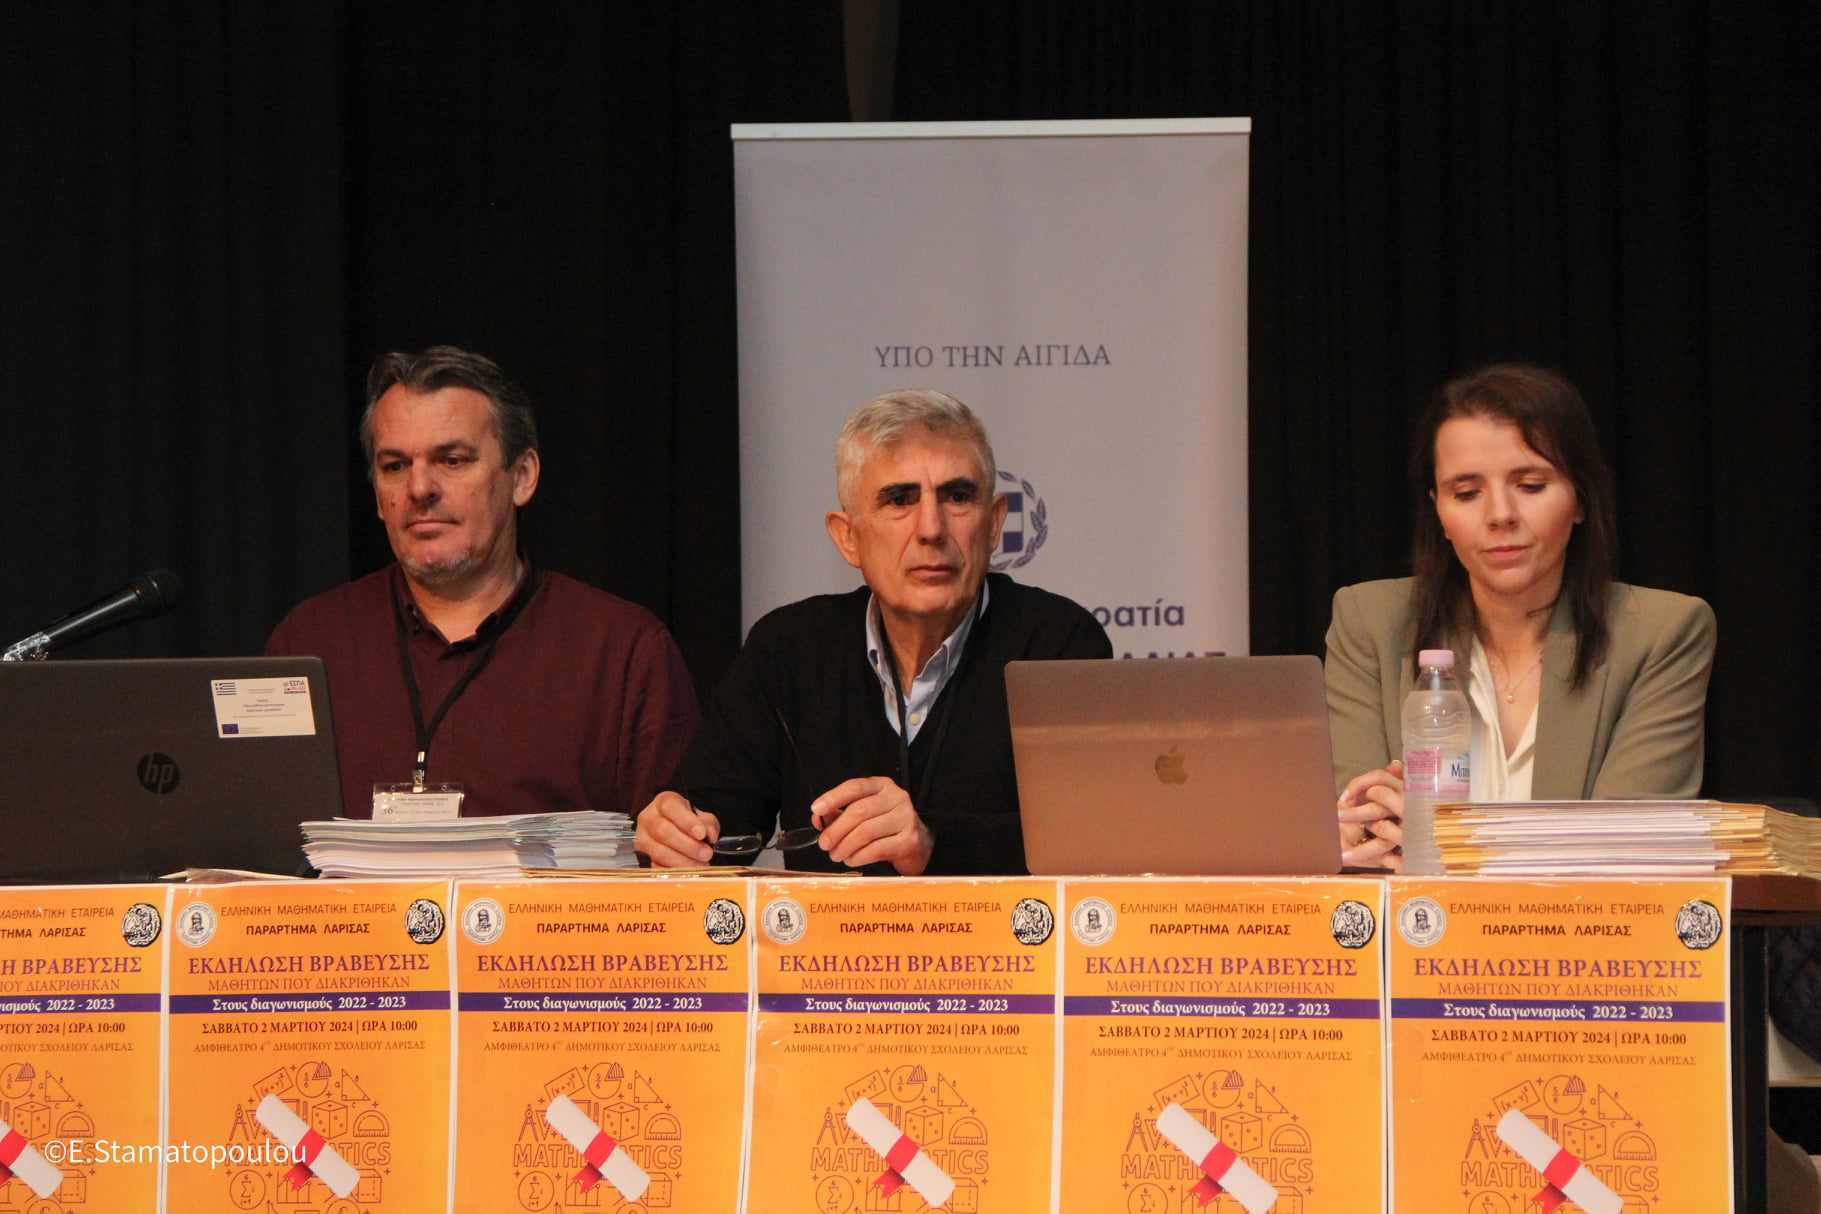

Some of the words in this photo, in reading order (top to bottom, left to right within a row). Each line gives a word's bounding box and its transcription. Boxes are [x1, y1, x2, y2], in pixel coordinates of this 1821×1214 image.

[875, 346, 933, 368] ΥΠΟ
[942, 345, 1005, 367] ΤΗΝ
[1013, 344, 1110, 366] ΑΙΓΙΔΑ
[221, 906, 271, 916] ΕΛΛΗΝΙΚΗ
[278, 904, 347, 915] ΜΑΘΗΜΑΤΙΚΗ
[353, 903, 396, 913] ΕΤΑΙΡΕΙΑ
[509, 904, 562, 913] ΕΛΛΗΝΙΚΗ
[569, 903, 641, 913] ΜΑΘΗΜΑΤΙΚΗ
[649, 902, 694, 912] ΕΤΑΙΡΕΙΑ
[810, 904, 864, 913] ΕΛΛΗΝΙΚΗ
[872, 903, 946, 912] ΜΑΘΗΜΑΤΙΚΗ
[954, 903, 1001, 912] ΕΤΑΙΡΕΙΑ
[1121, 903, 1177, 913] ΕΛΛΗΝΙΚΗ
[1185, 903, 1264, 914] ΜΑΘΗΜΑΤΙΚΗ
[1272, 905, 1321, 914] ΕΤΑΙΡΕΙΑ
[1450, 903, 1511, 914] ΕΛΛΗΝΙΚΗ
[1518, 903, 1602, 914] ΜΑΘΗΜΑΤΙΚΗ
[1611, 904, 1664, 915] ΕΤΑΙΡΕΙΑ
[40, 928, 86, 937] ΛΑΡΙΣΑΣ
[246, 925, 316, 936] ΠΑΡΑΡΤΗΜΑ
[324, 924, 370, 934] ΛΑΡΙΣΑΣ
[537, 924, 609, 933] ΠΑΡΑΡΤΗΜΑ
[617, 923, 666, 933] ΛΑΡΙΣΑΣ
[840, 923, 914, 933] ΠΑΡΑΡΤΗΜΑ
[922, 923, 972, 932] ΛΑΡΙΣΑΣ
[1150, 924, 1229, 934] ΠΑΡΑΡΤΗΜΑ
[1237, 925, 1291, 935] ΛΑΡΙΣΑΣ
[1483, 925, 1565, 936] ΠΑΡΑΡΤΗΜΑ
[1574, 926, 1632, 936] ΛΑΡΙΣΑΣ
[22, 957, 141, 975] ΒΡΑΒΕΥΣΗΣ
[189, 956, 303, 974] ΕΚΔΗΛΩΣΗ
[310, 954, 430, 972] ΒΡΑΒΕΥΣΗΣ
[478, 955, 595, 971] ΕΚΔΗΛΩΣΗ
[603, 955, 728, 971] ΒΡΑΒΕΥΣΗΣ
[780, 956, 900, 972] ΕΚΔΗΛΩΣΗ
[908, 956, 1035, 972] ΒΡΑΒΕΥΣΗΣ
[1086, 957, 1213, 975] ΕΚΔΗΛΩΣΗ
[1221, 958, 1357, 976] ΒΡΑΒΕΥΣΗΣ
[1414, 959, 1550, 977] ΕΚΔΗΛΩΣΗ
[1558, 960, 1702, 978] ΒΡΑΒΕΥΣΗΣ
[209, 979, 280, 991] ΜΑΘΗΤΩΝ
[284, 978, 311, 990] ΠΟΥ
[316, 976, 410, 989] ΔΙΑΚΡΙΘΗΚΑΝ
[499, 978, 571, 989] ΜΑΘΗΤΩΝ
[576, 978, 604, 988] ΠΟΥ
[609, 978, 706, 988] ΔΙΑΚΡΙΘΗΚΑΝ
[802, 978, 876, 990] ΜΑΘΗΤΩΝ
[880, 978, 909, 989] ΠΟΥ
[914, 978, 1013, 990] ΔΙΑΚΡΙΘΗΚΑΝ
[1107, 981, 1185, 993] ΜΑΘΗΤΩΝ
[1190, 981, 1221, 993] ΠΟΥ
[1226, 982, 1334, 994] ΔΙΑΚΡΙΘΗΚΑΝ
[1439, 983, 1521, 995] ΜΑΘΗΤΩΝ
[1527, 984, 1559, 995] ΠΟΥ
[1567, 984, 1678, 997] ΔΙΑΚΡΙΘΗΚΑΝ
[47, 1000, 74, 1011] 2022
[86, 999, 115, 1010] 2023
[212, 999, 247, 1012] Στους
[251, 998, 332, 1013] διαγωνισμούς
[339, 997, 367, 1008] 2022
[378, 997, 406, 1008] 2023
[504, 998, 540, 1010] Στους
[543, 997, 625, 1012] διαγωνισμούς
[633, 998, 662, 1009] 2022
[673, 998, 702, 1009] 2023
[806, 998, 842, 1012] Στους
[846, 998, 930, 1013] διαγωνισμούς
[937, 1000, 967, 1010] 2022
[978, 1000, 1008, 1010] 2023
[1111, 1001, 1149, 1015] Στους
[1153, 1001, 1245, 1017] διαγωνισμούς
[1253, 1003, 1285, 1014] 2022
[1298, 1004, 1330, 1015] 2023
[1444, 1003, 1485, 1018] Στους
[1489, 1003, 1585, 1020] διαγωνισμούς
[1593, 1007, 1627, 1018] 2022
[1640, 1007, 1673, 1019] 2023
[35, 1024, 59, 1033] 2024
[69, 1023, 93, 1033] ΩΡΑ
[98, 1023, 125, 1032] 10:00
[202, 1023, 258, 1034] ΣΑΒΒΑΤΟ
[262, 1022, 267, 1033] 2
[270, 1021, 325, 1032] ΜΑΡΤΙΟΥ
[329, 1021, 353, 1031] 2024
[362, 1021, 386, 1031] ΩΡΑ
[391, 1021, 417, 1030] 10:00
[493, 1022, 550, 1032] ΣΑΒΒΑΤΟ
[553, 1023, 559, 1032] 2
[563, 1022, 618, 1032] ΜΑΡΤΙΟΥ
[623, 1023, 647, 1032] 2024
[656, 1023, 681, 1032] ΩΡΑ
[686, 1023, 713, 1032] 10:00
[793, 1024, 852, 1034] ΣΑΒΒΑΤΟ
[856, 1024, 862, 1034] 2
[866, 1024, 922, 1034] ΜΑΡΤΙΟΥ
[927, 1024, 951, 1034] 2024
[961, 1024, 987, 1034] ΩΡΑ
[992, 1025, 1020, 1034] 10:00
[1099, 1027, 1160, 1037] ΣΑΒΒΑΤΟ
[1164, 1027, 1171, 1037] 2
[1174, 1027, 1237, 1039] ΜΑΡΤΙΟΥ
[1241, 1028, 1269, 1039] 2024
[1280, 1029, 1307, 1040] ΩΡΑ
[1312, 1030, 1343, 1041] 10:00
[1432, 1030, 1497, 1042] ΣΑΒΒΑΤΟ
[1502, 1031, 1509, 1042] 2
[1513, 1031, 1578, 1043] ΜΑΡΤΙΟΥ
[1582, 1032, 1611, 1044] 2024
[1621, 1033, 1650, 1044] ΩΡΑ
[1655, 1034, 1686, 1045] 10:00
